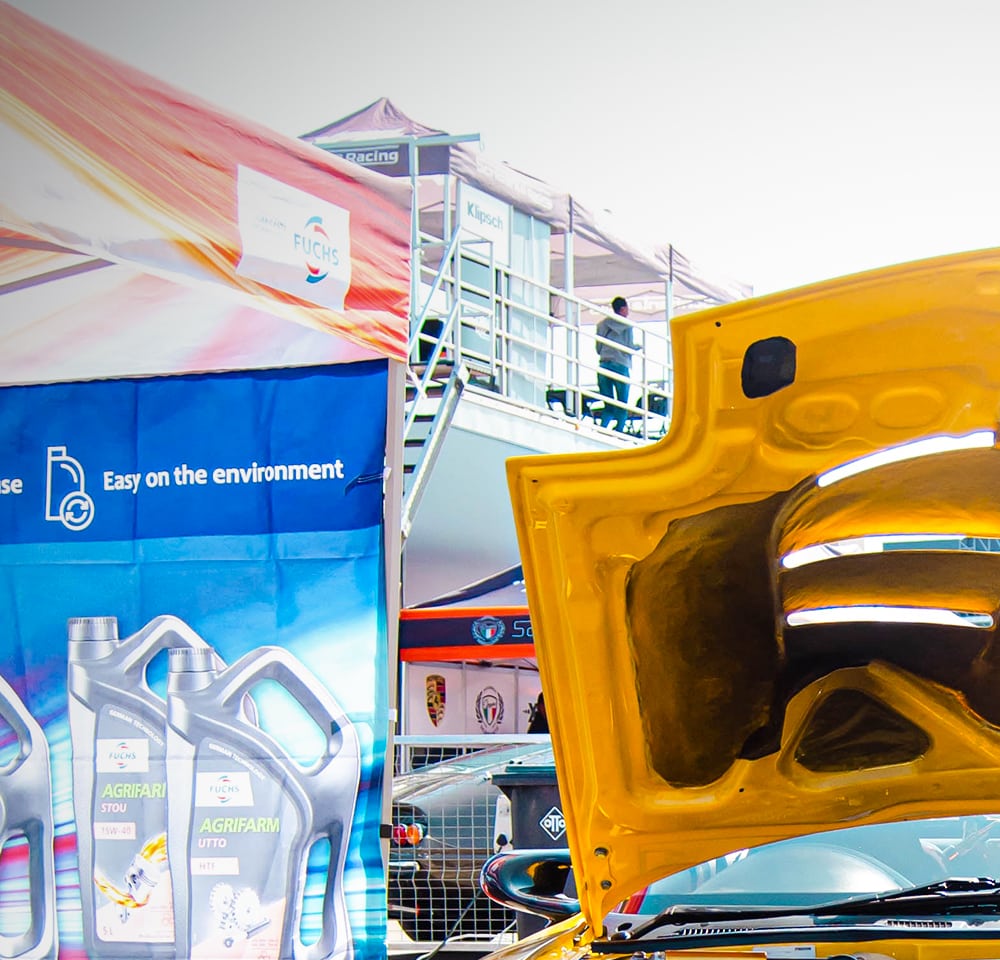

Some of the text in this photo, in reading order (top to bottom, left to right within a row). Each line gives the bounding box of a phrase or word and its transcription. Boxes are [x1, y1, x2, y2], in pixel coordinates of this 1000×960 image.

[467, 202, 503, 230] Klipsch
[293, 233, 340, 267] FUCHS
[103, 459, 345, 494] Easy on the environment
[109, 752, 136, 760] FUCHS
[209, 785, 240, 793] FUCHS
[100, 802, 127, 813] STOU
[200, 816, 280, 833] AGRIFARM
[543, 814, 566, 832] OTTO
[198, 838, 227, 849] UTTO
